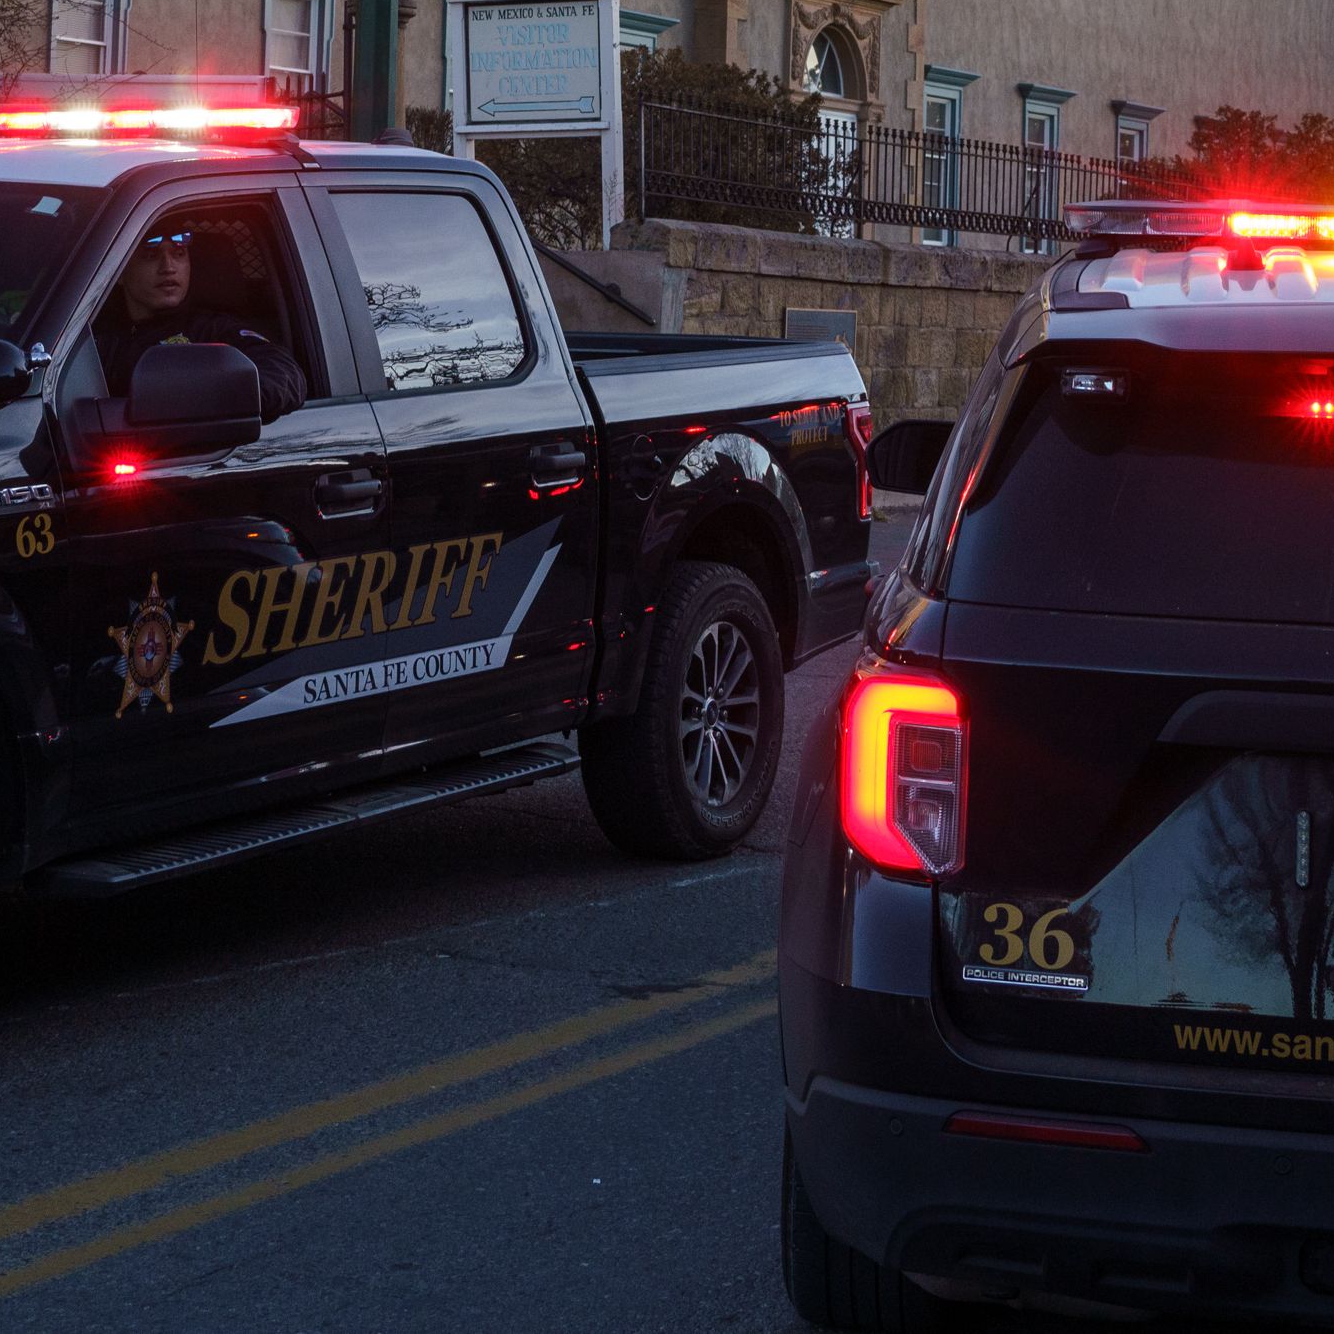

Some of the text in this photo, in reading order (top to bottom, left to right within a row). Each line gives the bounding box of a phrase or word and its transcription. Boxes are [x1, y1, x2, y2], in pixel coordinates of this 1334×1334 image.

[472, 5, 595, 21] NEW MEXICO & SANTA FE
[496, 23, 571, 46] VISITOR
[471, 47, 597, 72] INFORMATION
[498, 74, 570, 96] CENTER
[779, 410, 792, 427] TO
[791, 426, 829, 446] PROTECT
[15, 512, 55, 559] 63
[202, 531, 504, 666] SHERIFF
[302, 642, 496, 704] SANTA FE COUNTY
[979, 903, 1076, 970] 36
[966, 968, 1085, 987] POLICE INTERCEPTOR
